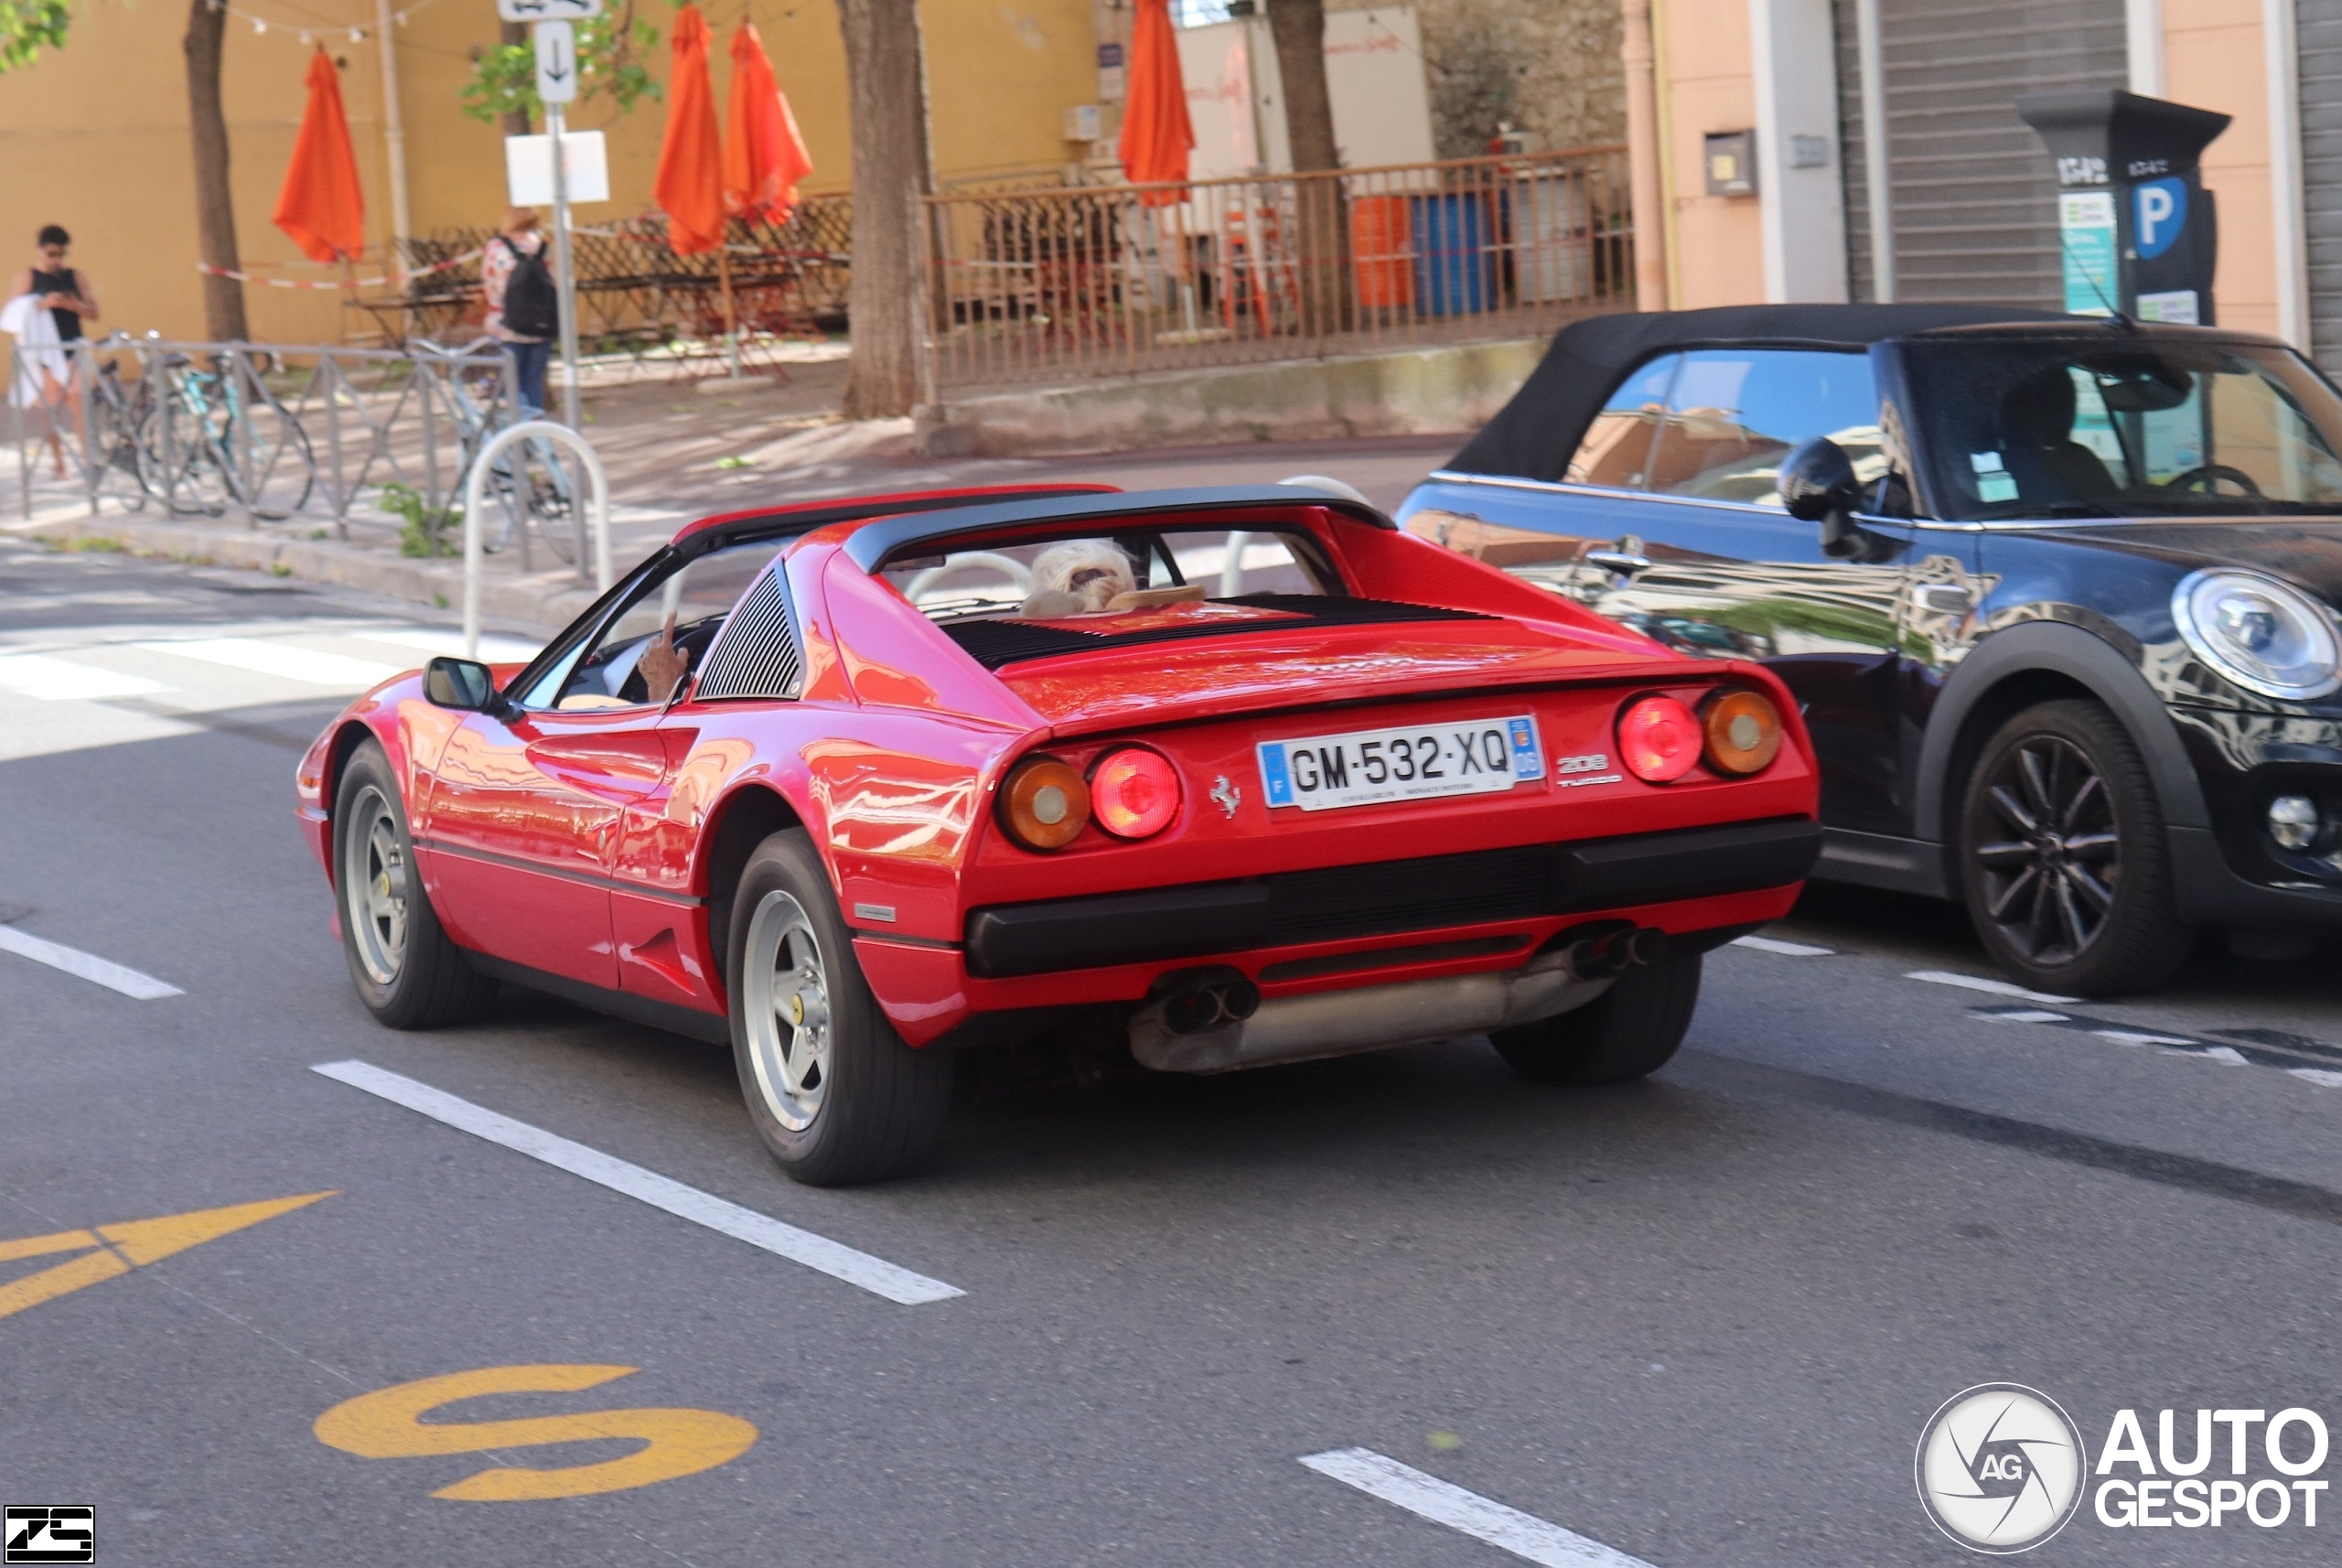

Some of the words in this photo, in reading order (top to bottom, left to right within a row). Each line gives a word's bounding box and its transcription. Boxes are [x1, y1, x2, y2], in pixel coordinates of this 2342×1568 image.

[2139, 187, 2174, 244] P
[1292, 729, 1508, 792] GM-532-XQ
[1557, 754, 1609, 774] 208
[1273, 780, 1284, 794] F
